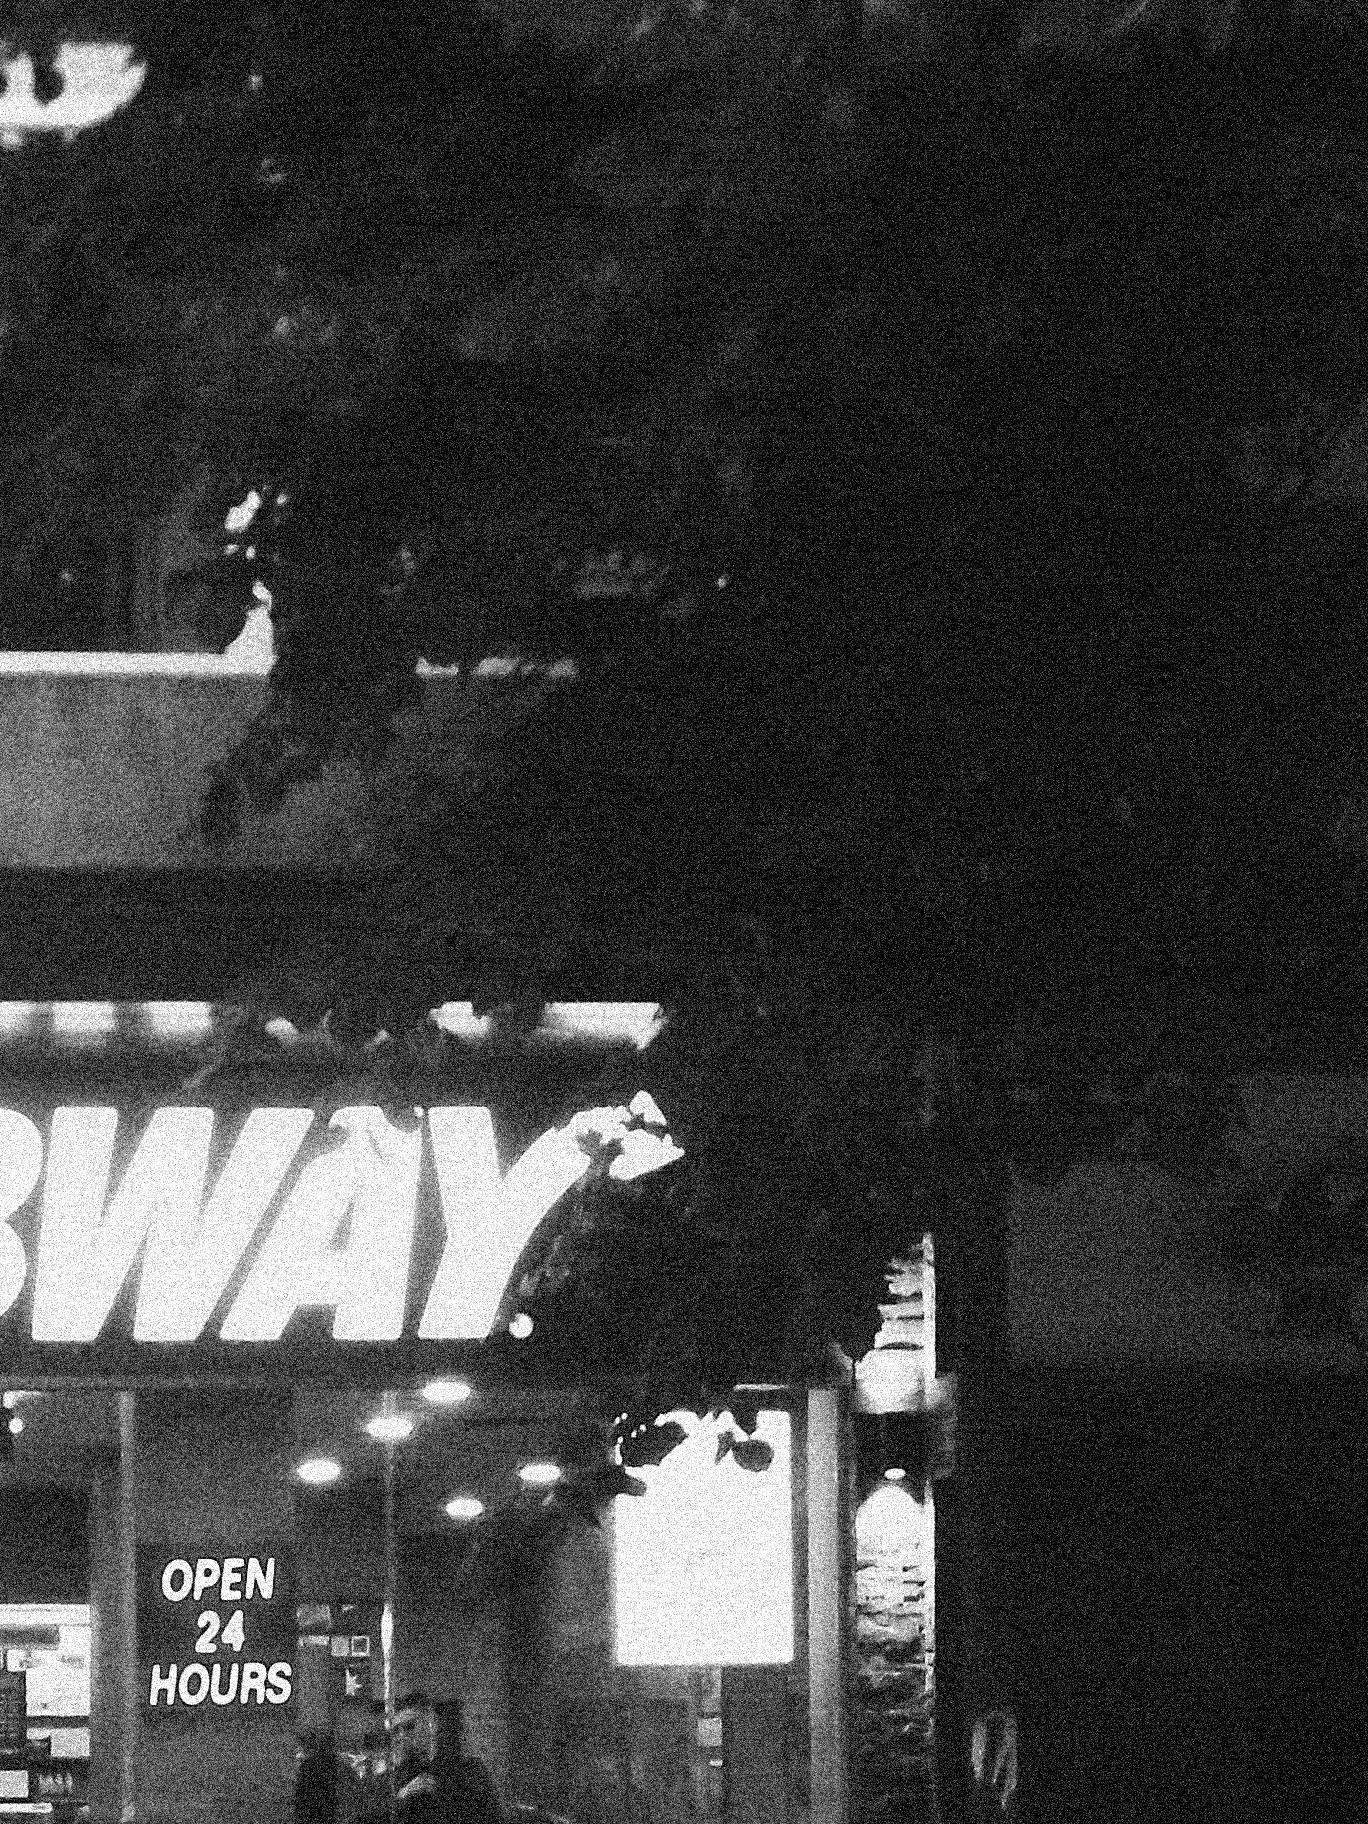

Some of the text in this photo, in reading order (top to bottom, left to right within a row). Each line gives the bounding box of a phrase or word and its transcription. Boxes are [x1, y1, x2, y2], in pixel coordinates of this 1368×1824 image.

[161, 1557, 276, 1601] OPEN
[194, 1609, 245, 1653] 24
[149, 1661, 292, 1705] HOURS
